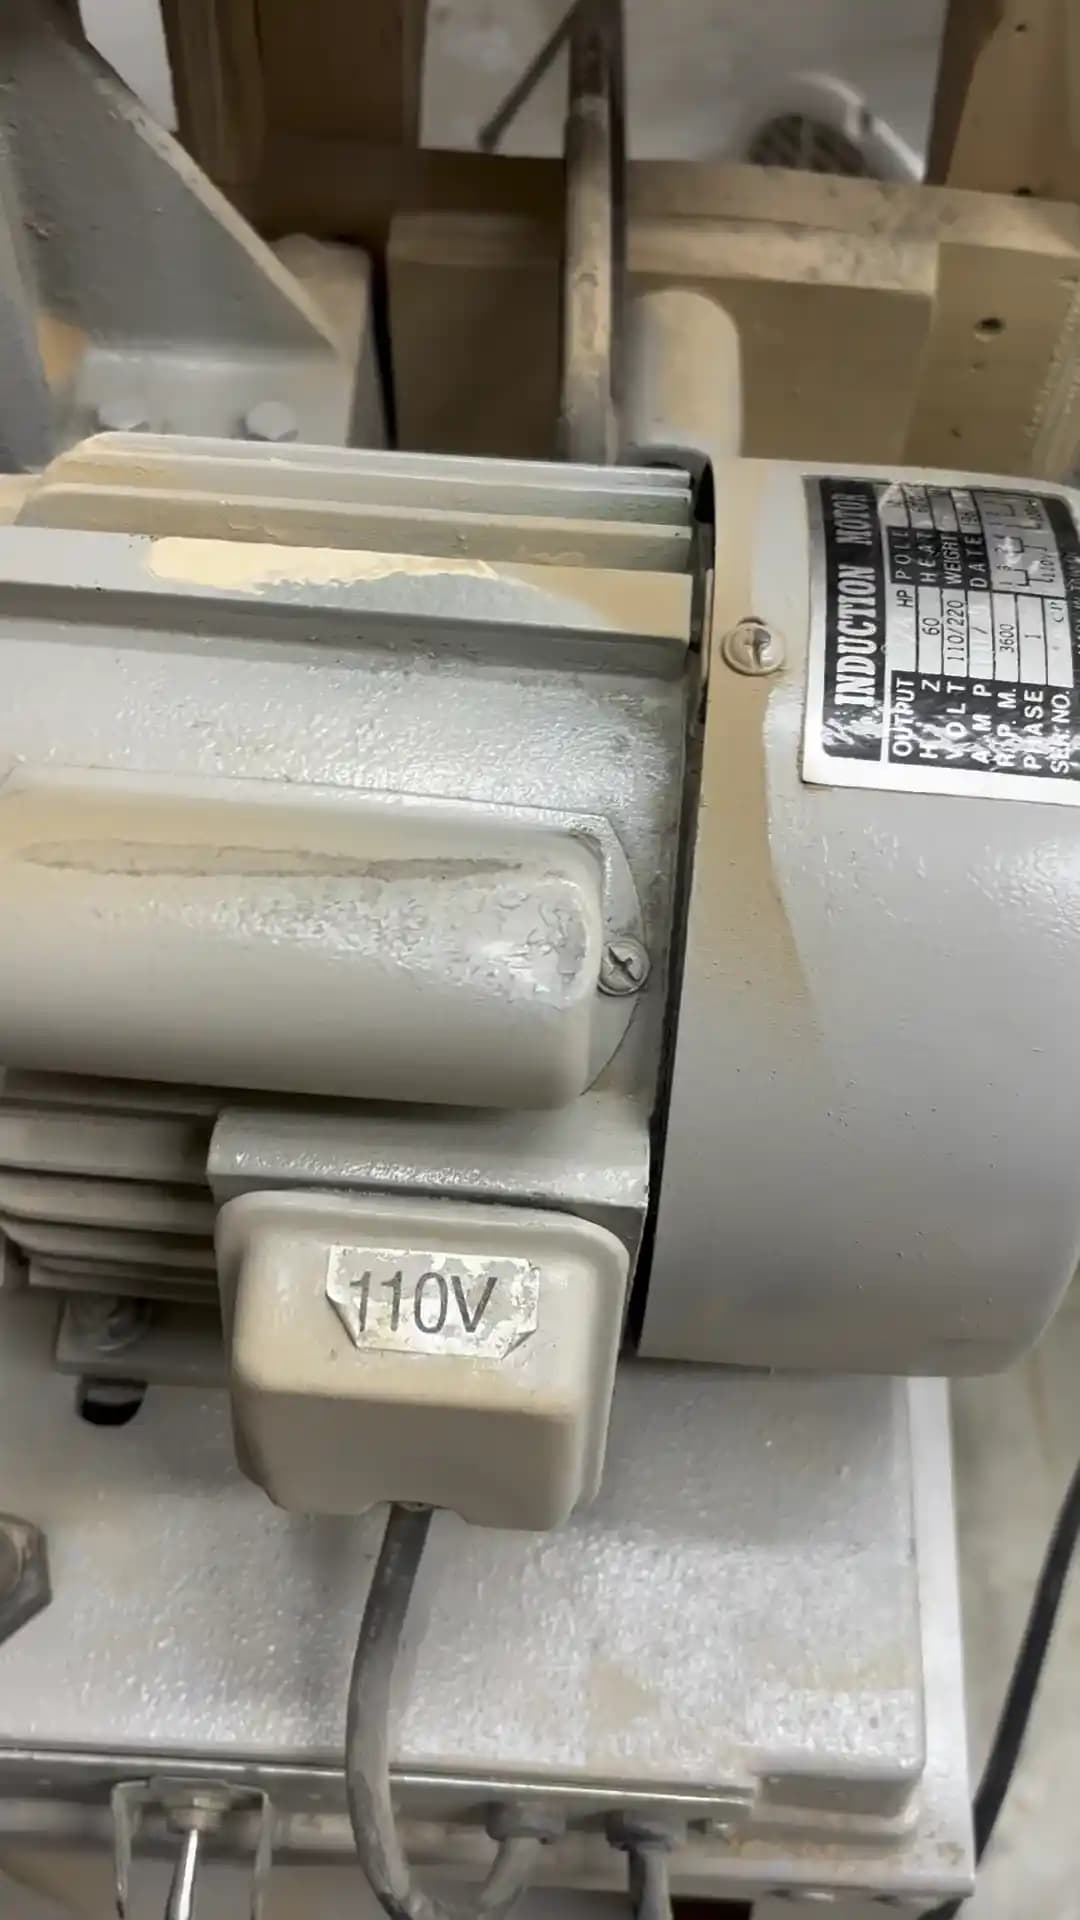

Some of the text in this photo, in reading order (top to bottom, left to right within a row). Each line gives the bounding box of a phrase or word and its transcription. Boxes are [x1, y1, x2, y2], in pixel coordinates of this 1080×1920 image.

[916, 532, 936, 582] HEAT
[941, 535, 962, 584] WEIGHT
[965, 536, 987, 588] DATE
[831, 492, 876, 707] INDUCTION MOTOR
[895, 589, 913, 608] HP
[921, 617, 940, 636] 60
[946, 600, 964, 662] 110/220
[999, 623, 1014, 653] 3600
[892, 678, 914, 756] OUTPUT
[996, 689, 1016, 767] RP.M.
[350, 1271, 498, 1334] 110V
